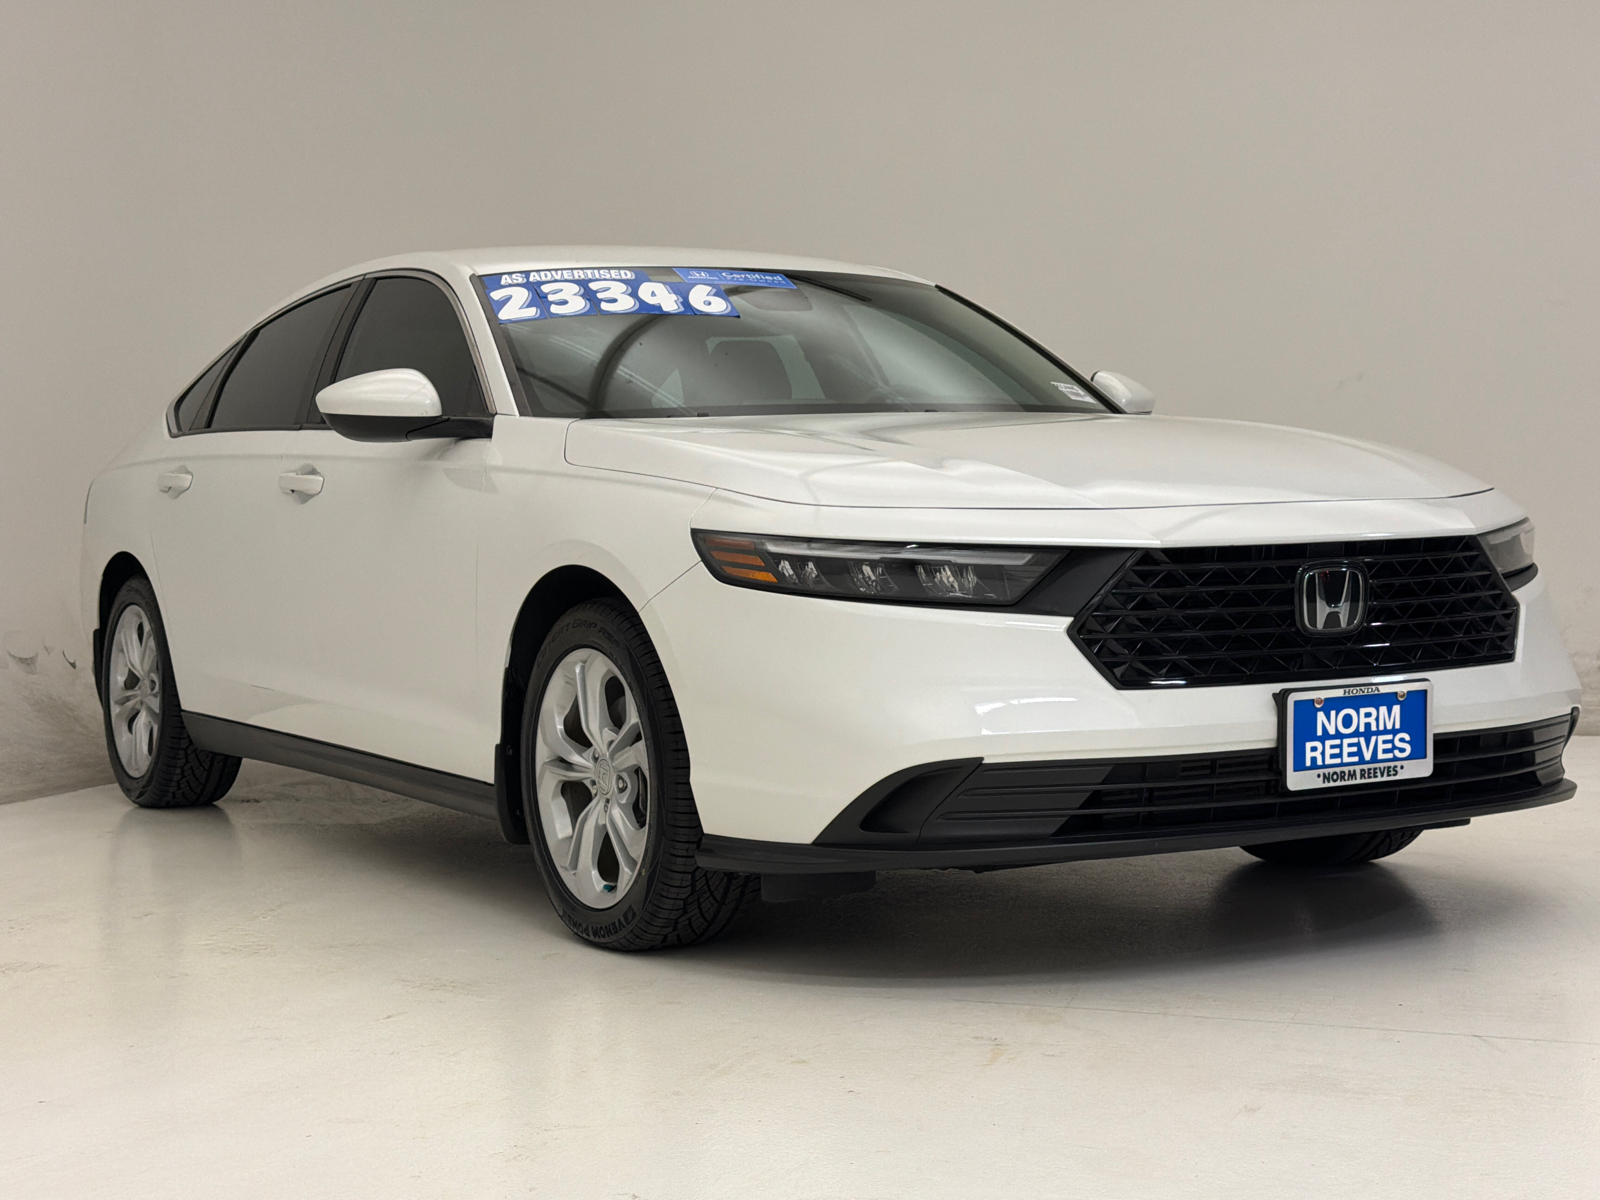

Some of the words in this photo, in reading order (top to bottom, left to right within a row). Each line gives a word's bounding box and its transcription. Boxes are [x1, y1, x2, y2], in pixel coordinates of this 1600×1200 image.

[501, 273, 527, 286] AS
[529, 269, 635, 282] ADVERTISED
[721, 272, 782, 281] Certified
[1342, 686, 1381, 696] HONDA
[1316, 704, 1401, 737] NORM
[1305, 732, 1412, 767] REEVES
[1322, 769, 1358, 784] NORM
[1359, 765, 1399, 777] REEVES
[591, 917, 626, 939] VENOM
